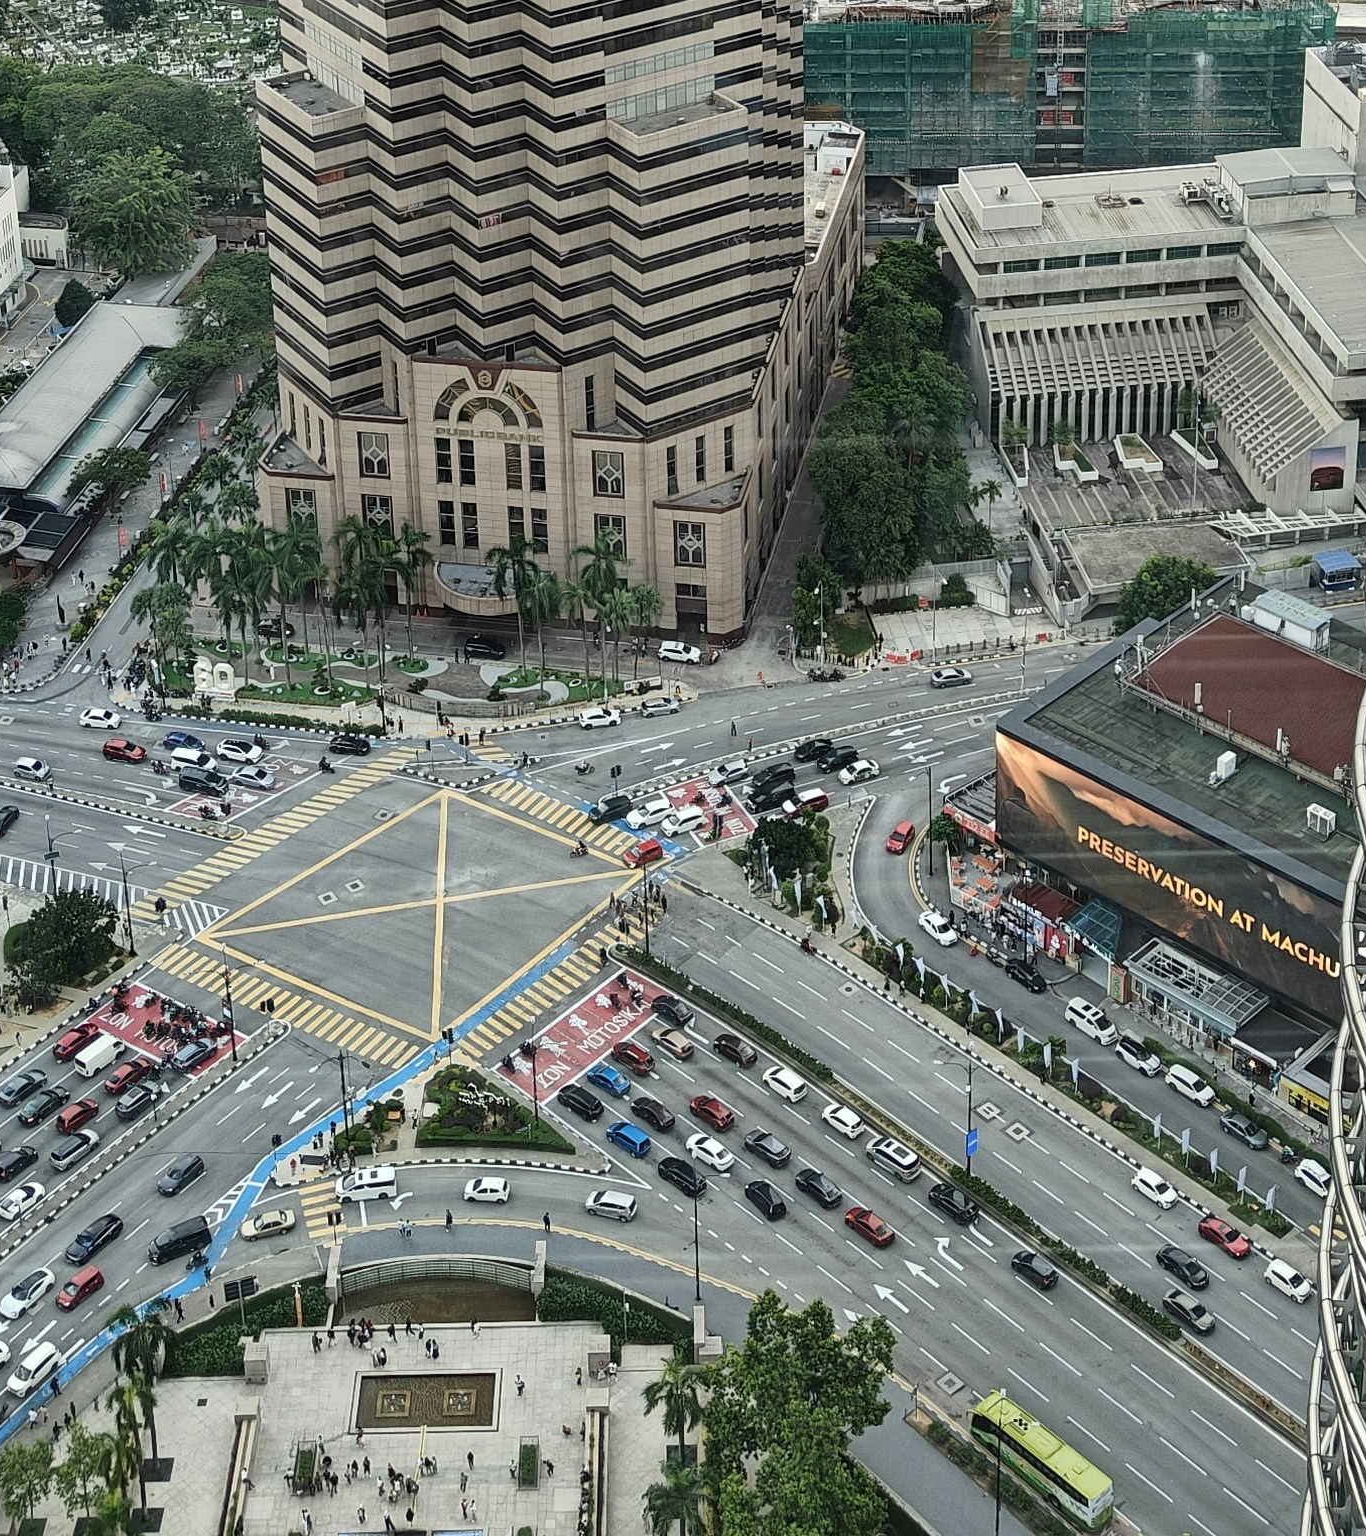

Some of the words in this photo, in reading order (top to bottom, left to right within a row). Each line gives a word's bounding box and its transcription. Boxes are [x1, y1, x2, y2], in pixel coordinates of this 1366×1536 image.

[435, 426, 495, 439] PUBLIC
[496, 431, 544, 444] BANK
[1076, 824, 1225, 919] PRESERVATION
[1229, 908, 1257, 934] AT
[1261, 922, 1342, 979] MACHU
[537, 1059, 572, 1089] ZON
